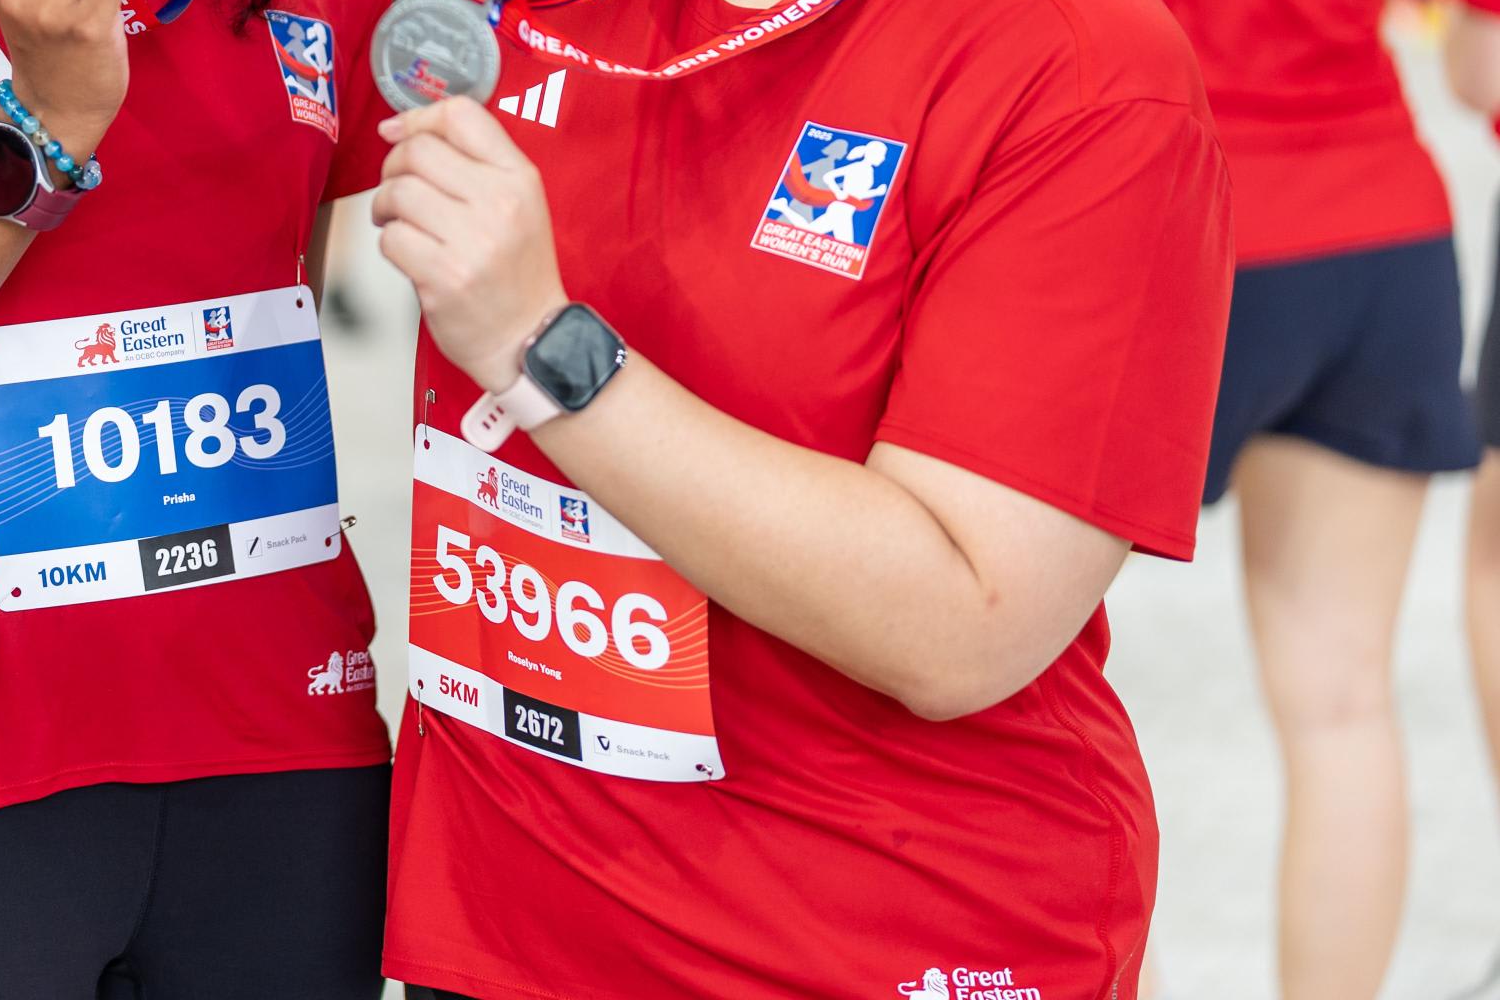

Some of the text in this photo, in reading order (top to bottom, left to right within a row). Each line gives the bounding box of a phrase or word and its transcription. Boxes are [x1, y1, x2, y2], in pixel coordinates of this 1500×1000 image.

[518, 19, 590, 65] GREAT
[807, 128, 833, 141] 2025
[759, 233, 853, 271] WOMEN'S RUN
[763, 222, 864, 262] GREAT EASTERN
[120, 316, 166, 336] Great
[122, 333, 185, 352] Eastern
[156, 349, 185, 358] Company
[38, 384, 286, 488] 10183
[163, 492, 196, 506] Prisha
[501, 472, 531, 498] Great
[502, 488, 543, 520] Eastern
[267, 533, 307, 549] Snack Pack
[155, 539, 218, 577] 2236
[38, 561, 107, 588] 10KM
[432, 524, 671, 670] 53966
[507, 650, 562, 681] Roselyn Yong
[439, 674, 479, 707] 5KM
[515, 704, 565, 746] 2672
[616, 745, 670, 761] Snack Pack
[951, 967, 1014, 987] Great
